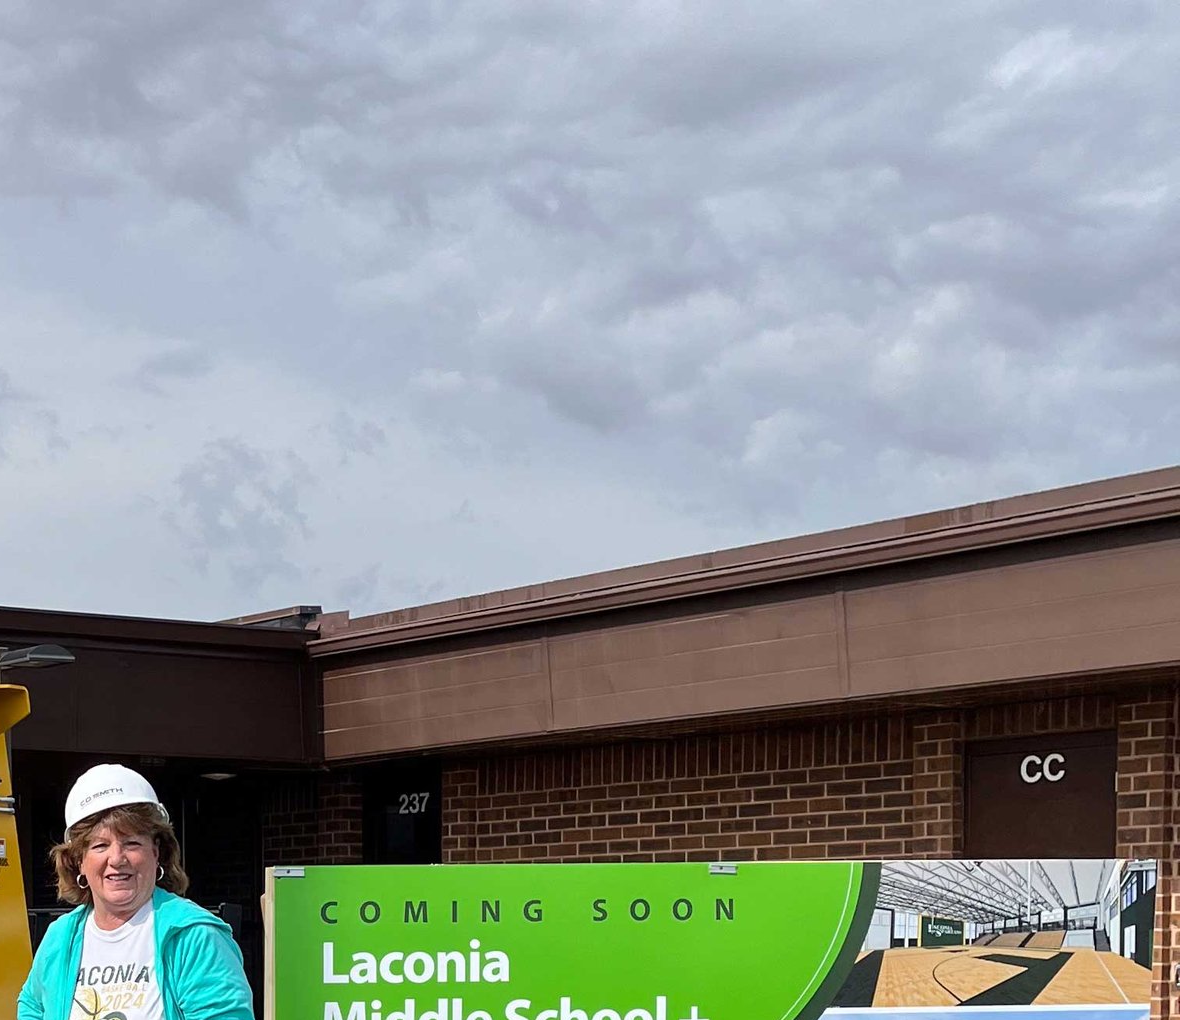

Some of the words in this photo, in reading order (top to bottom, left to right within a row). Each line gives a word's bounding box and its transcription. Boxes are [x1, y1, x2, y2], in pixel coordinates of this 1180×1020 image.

[1020, 753, 1066, 784] CC
[399, 792, 430, 814] 237
[320, 899, 544, 925] COMING
[592, 897, 735, 922] SOON
[322, 938, 510, 984] Laconia
[77, 963, 150, 987] ACONIA
[102, 992, 145, 1012] 2024
